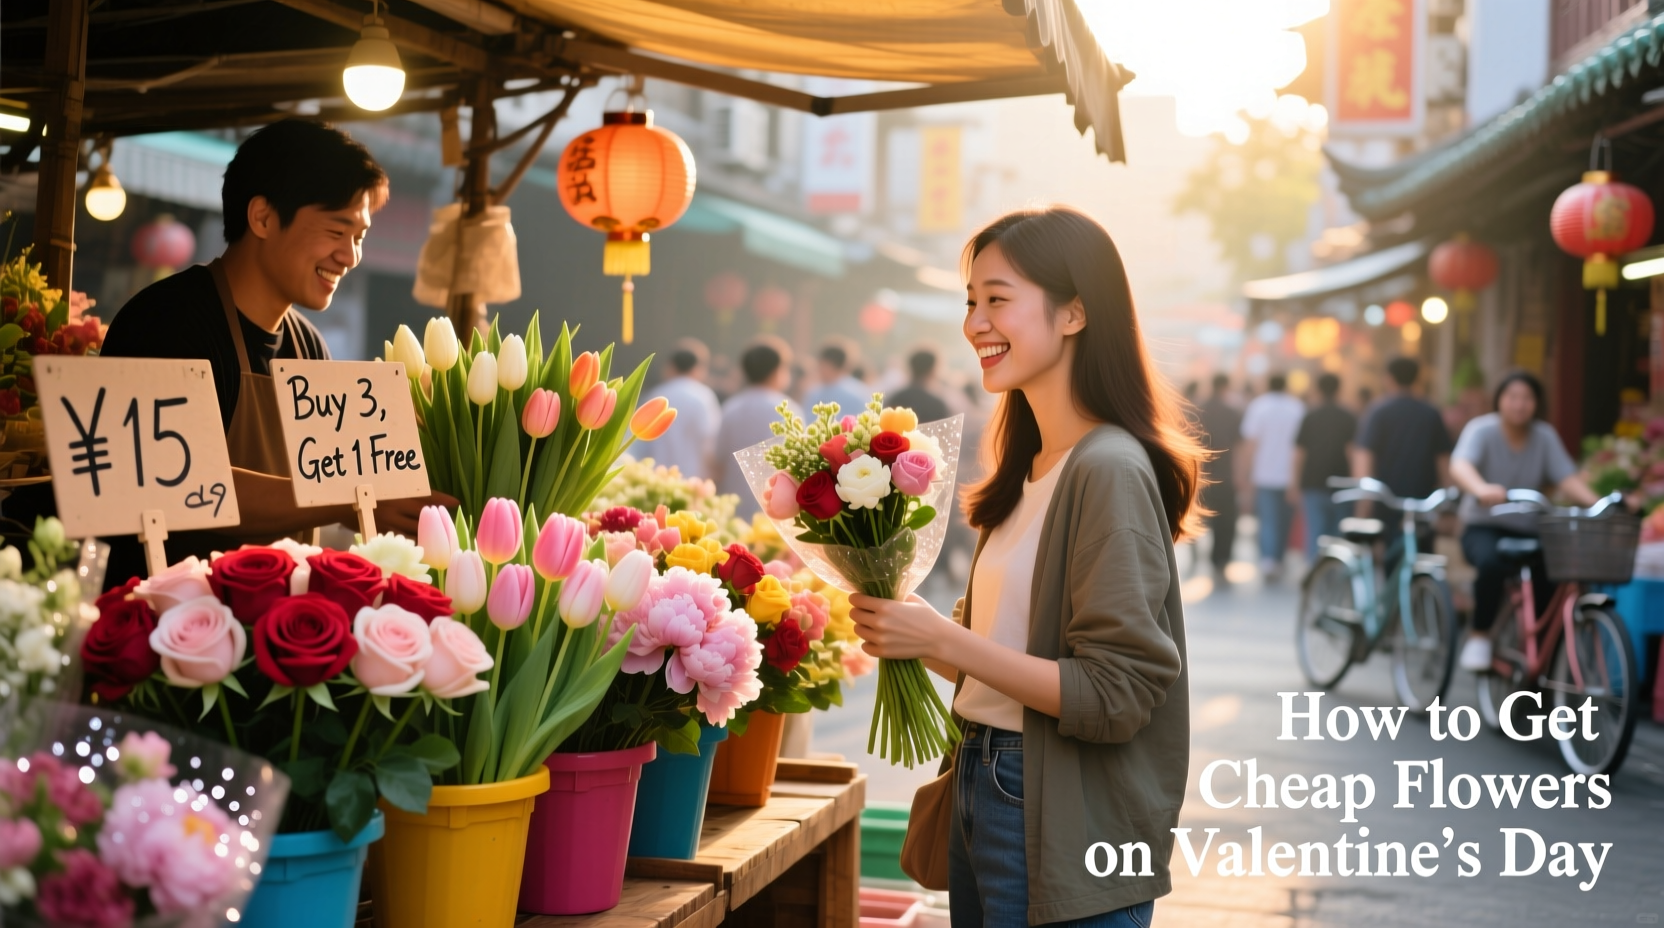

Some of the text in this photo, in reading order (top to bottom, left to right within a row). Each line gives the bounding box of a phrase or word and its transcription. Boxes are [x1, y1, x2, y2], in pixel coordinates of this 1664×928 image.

[286, 375, 386, 433] Buy 3,
[59, 386, 192, 497] ¥15
[297, 433, 421, 484] Get 1 Free
